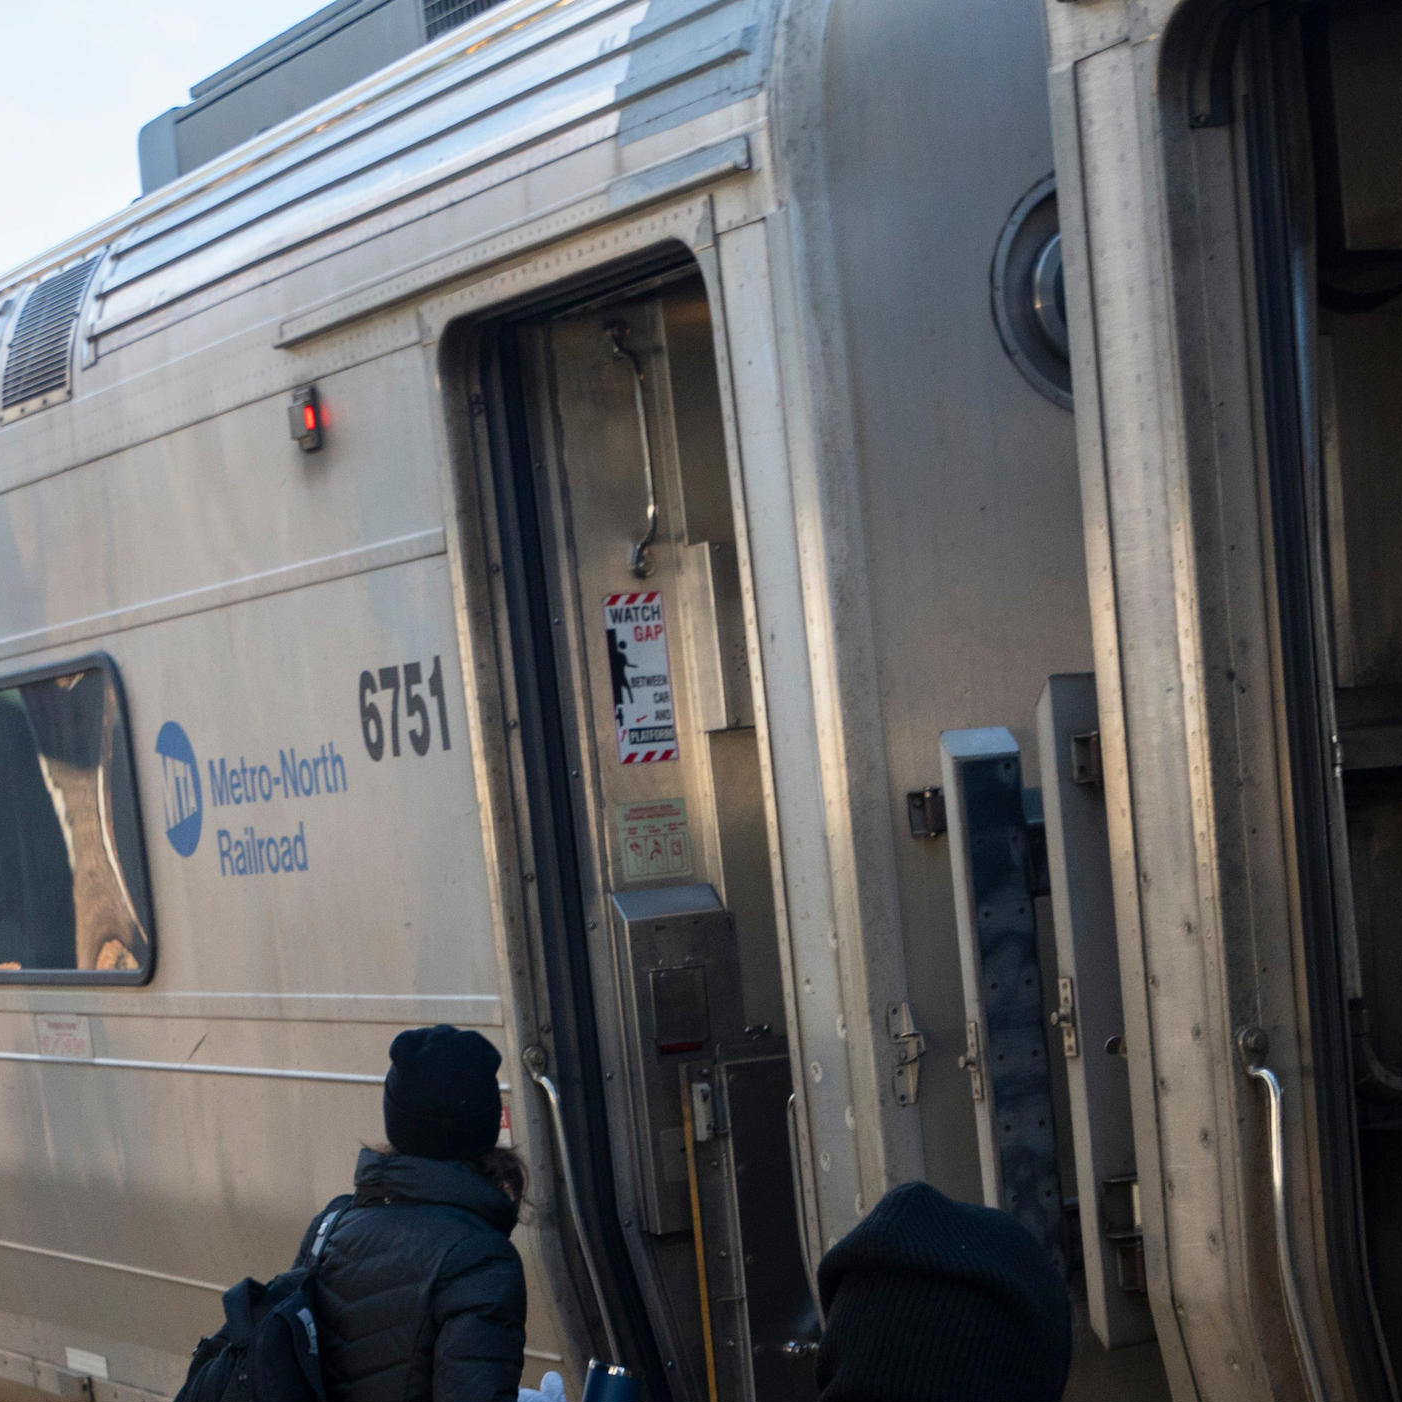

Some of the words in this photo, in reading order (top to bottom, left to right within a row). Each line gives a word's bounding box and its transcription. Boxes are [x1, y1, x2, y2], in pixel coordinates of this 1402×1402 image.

[609, 604, 661, 624] WATCH
[633, 624, 663, 642] GAP
[630, 674, 668, 689] BETWEEN
[653, 691, 670, 704] CAR
[359, 655, 452, 762] 6751
[654, 708, 671, 721] AND
[629, 727, 674, 744] PLATFORM
[208, 741, 348, 808] Metro-North
[217, 821, 309, 877] Railroad
